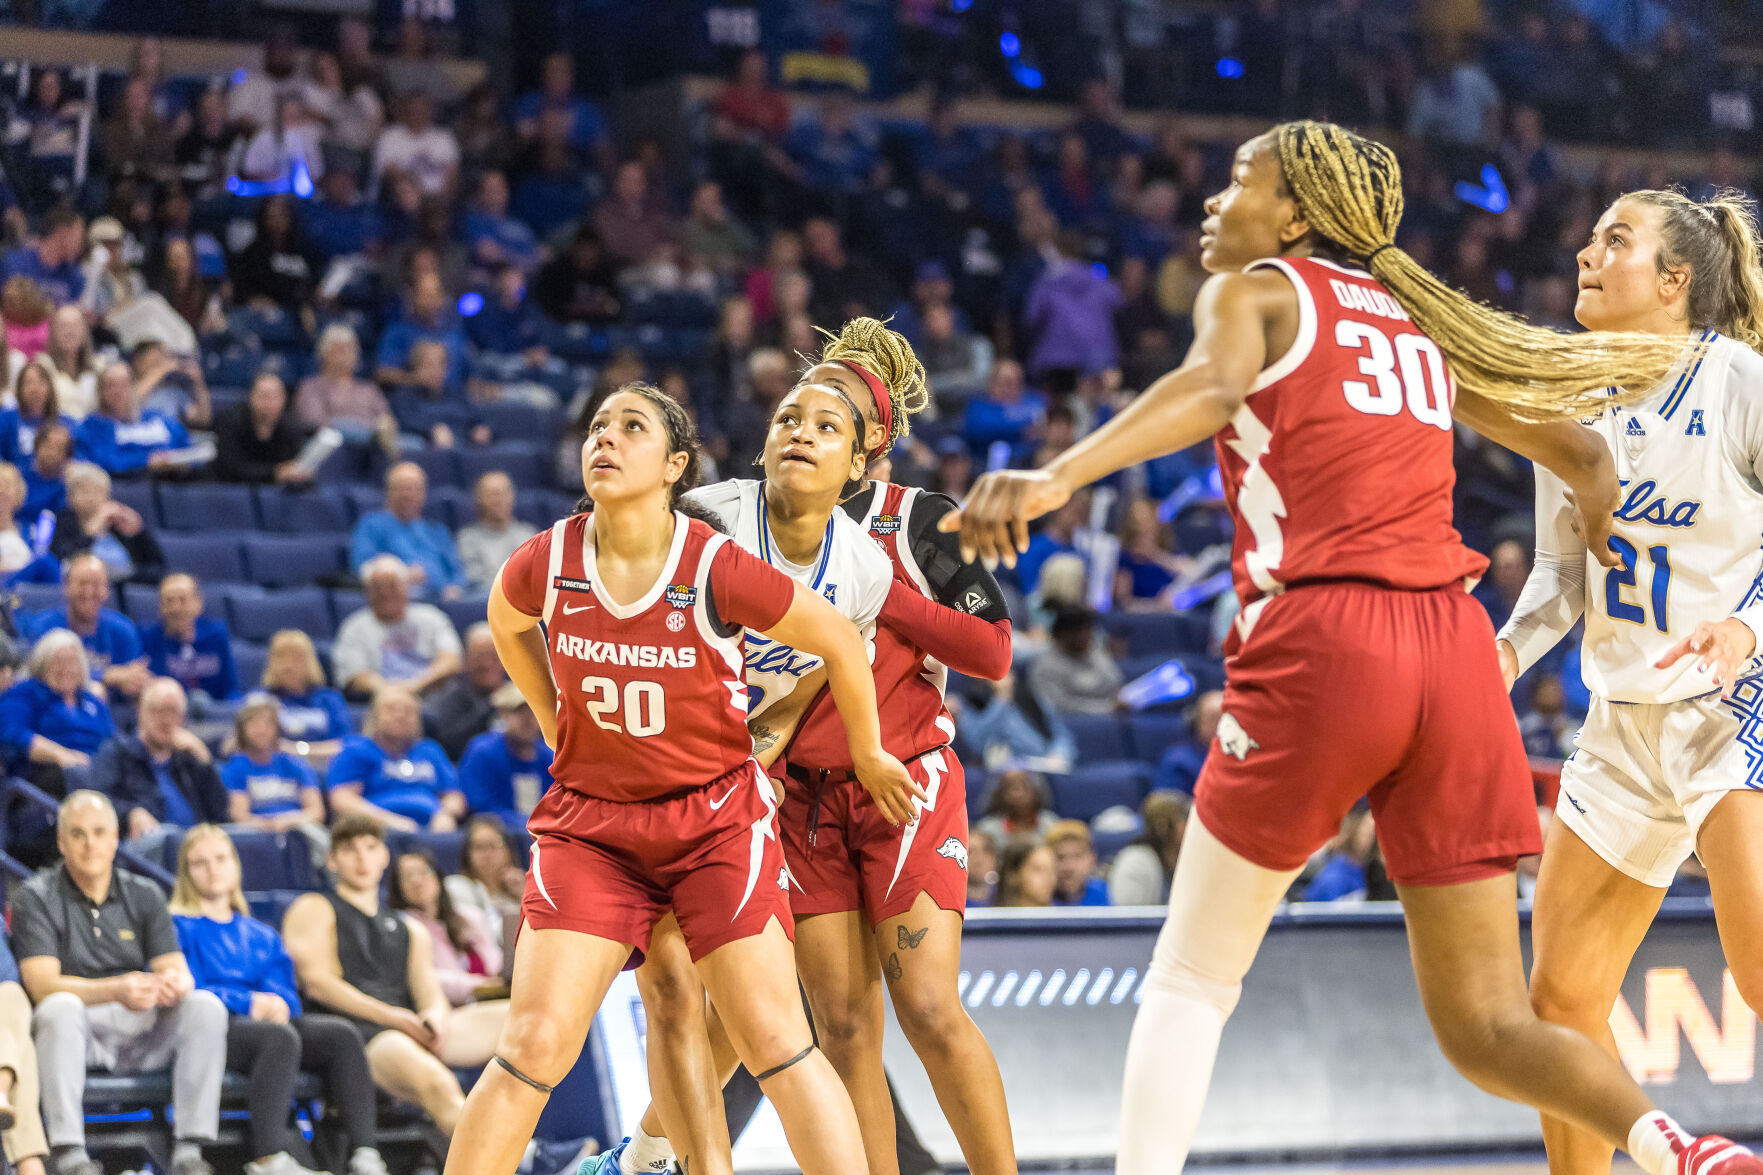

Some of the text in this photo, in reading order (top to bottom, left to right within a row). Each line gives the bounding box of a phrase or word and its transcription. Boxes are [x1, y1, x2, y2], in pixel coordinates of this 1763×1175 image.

[1335, 319, 1452, 431] 30
[561, 579, 590, 590] TOGETHER
[667, 592, 696, 601] WBIT
[1605, 534, 1671, 633] 21
[668, 615, 685, 629] SEC
[556, 632, 697, 669] ARKANSAS
[580, 675, 667, 738] 20
